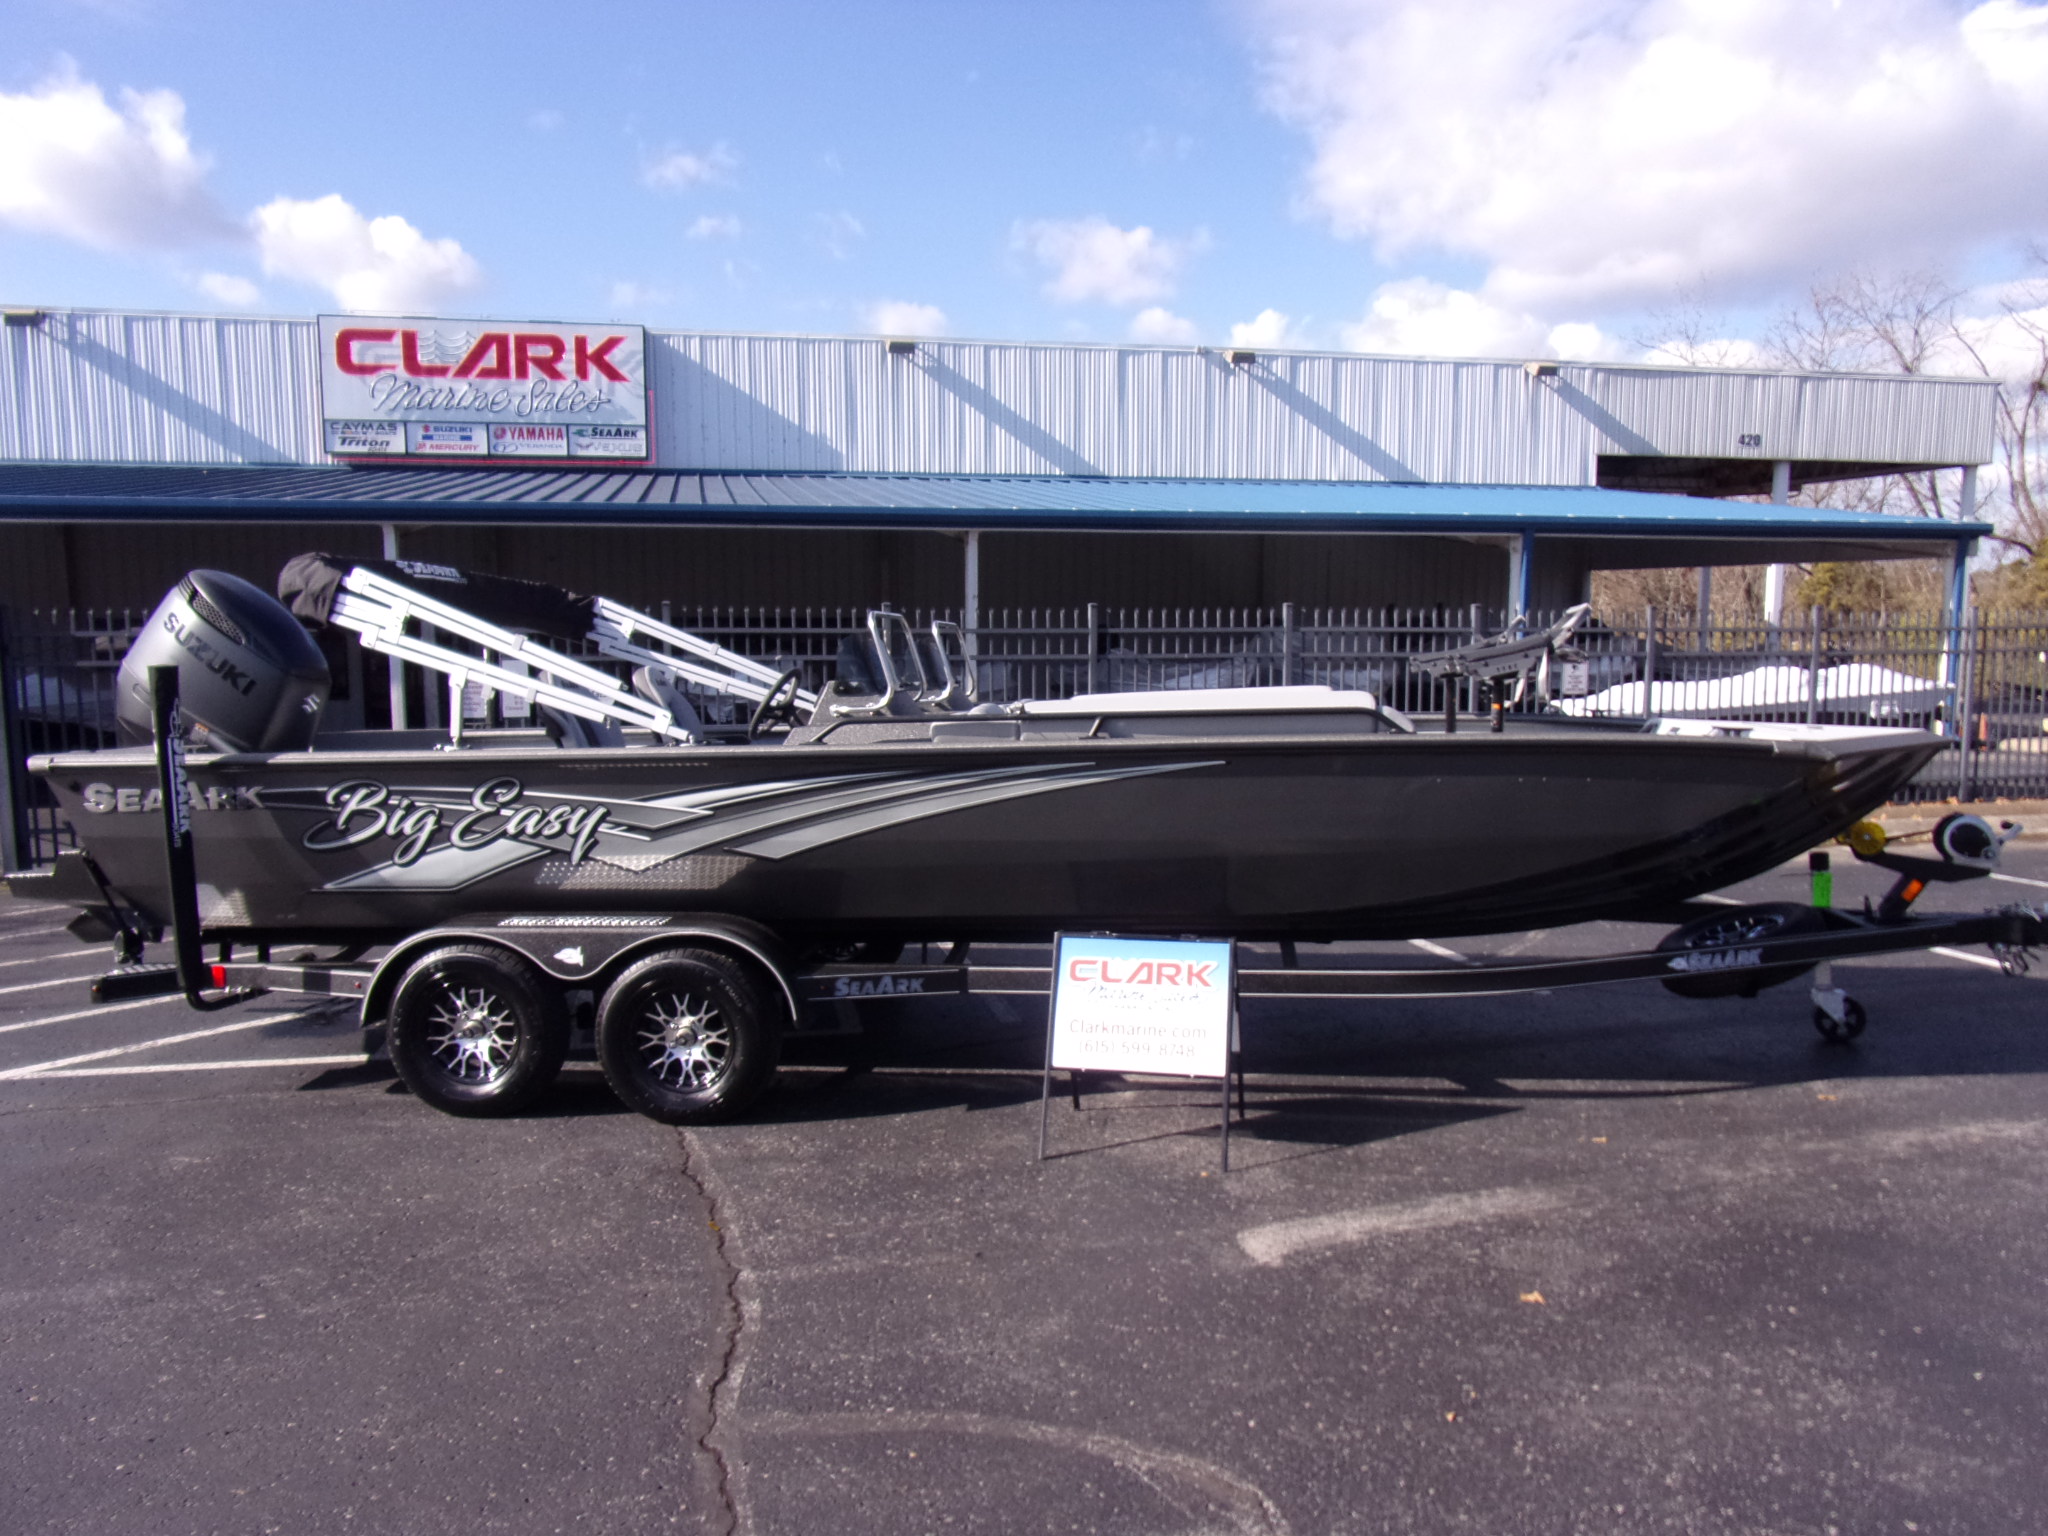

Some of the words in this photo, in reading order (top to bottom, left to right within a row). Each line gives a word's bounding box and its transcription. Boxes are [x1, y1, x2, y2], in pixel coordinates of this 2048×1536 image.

[335, 328, 631, 382] CLARK
[369, 372, 510, 412] Marine
[514, 377, 611, 417] Sales
[330, 421, 397, 431] CAYMAS
[509, 426, 564, 441] YAMAHA
[338, 436, 391, 447] Triton
[429, 443, 480, 452] MERCURY
[163, 612, 257, 696] SUZUKI
[303, 778, 441, 867] Big
[450, 776, 609, 866] Easy
[1069, 959, 1213, 987] CLARK
[1069, 1018, 1207, 1039] Clarkmarinecom
[1079, 1039, 1115, 1054] (615)
